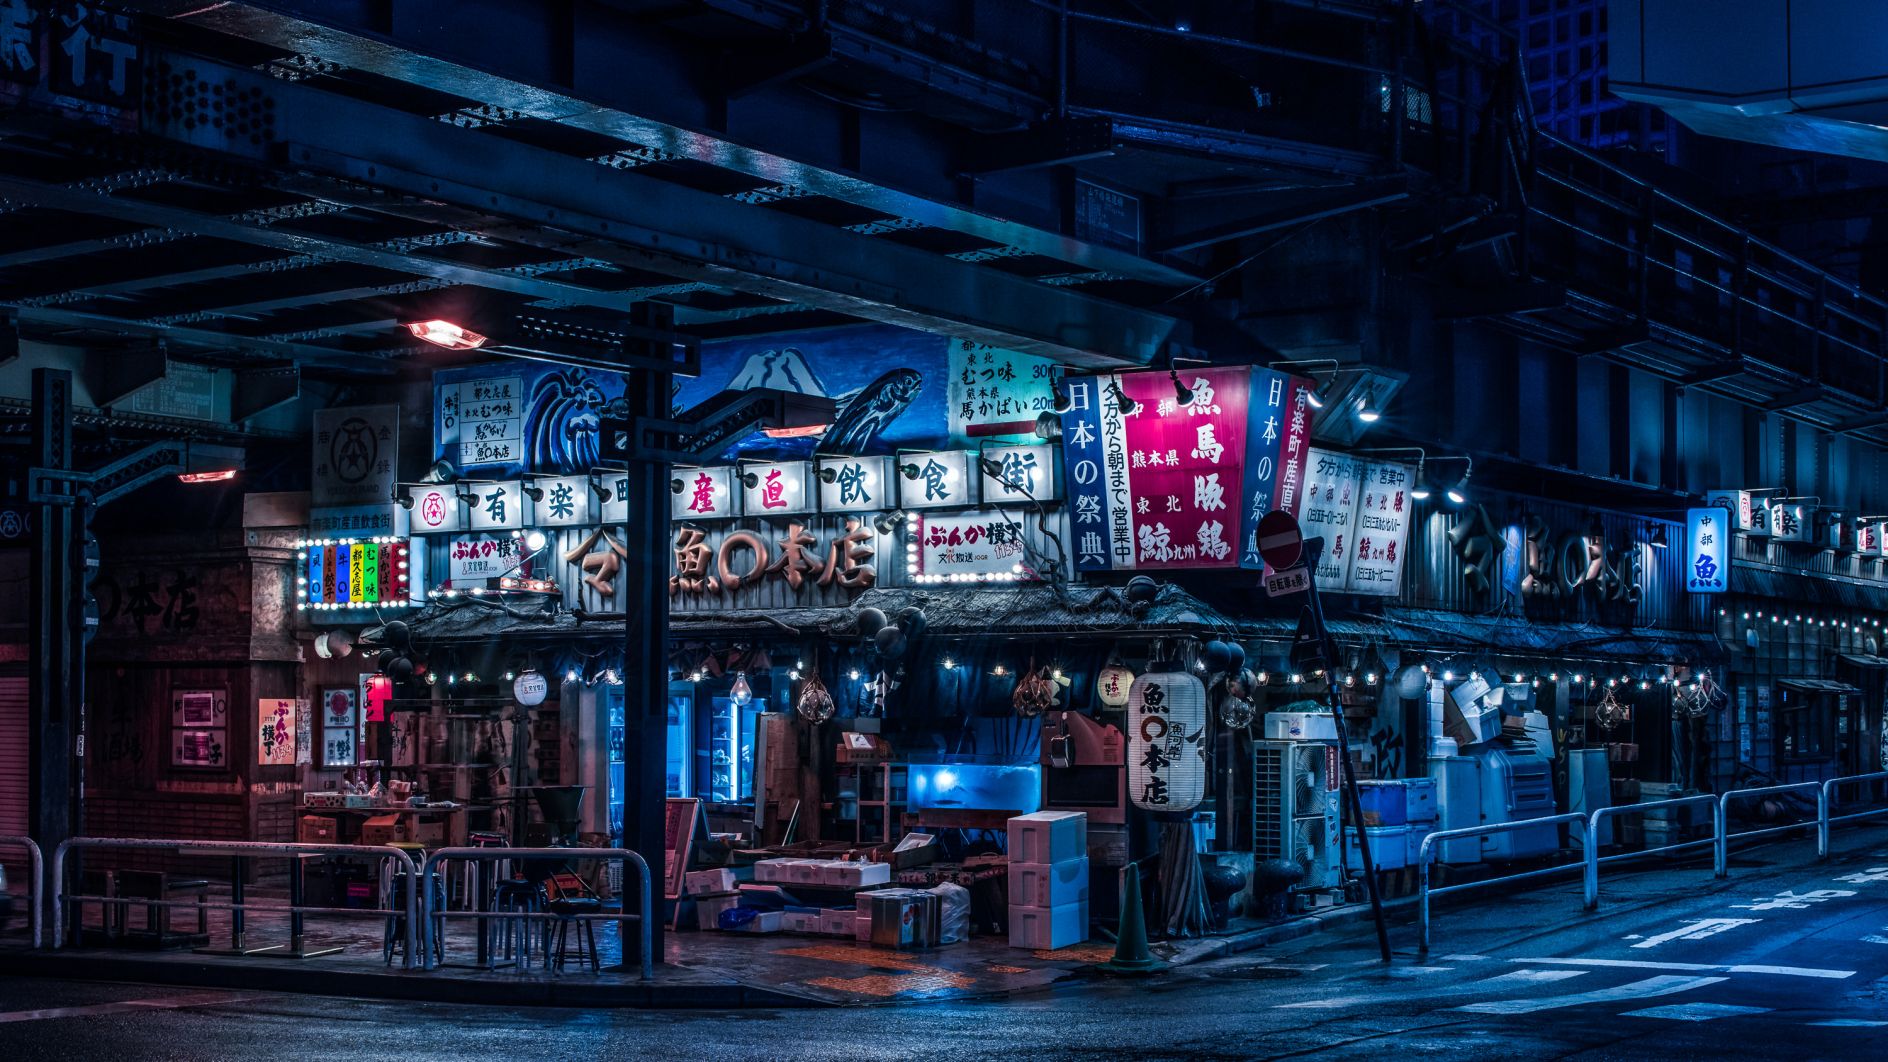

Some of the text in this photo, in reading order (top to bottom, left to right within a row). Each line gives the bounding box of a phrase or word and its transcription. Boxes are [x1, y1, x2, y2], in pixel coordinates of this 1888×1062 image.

[961, 361, 1016, 386] むつ味
[967, 352, 994, 366] 東北
[960, 397, 1028, 421] 馬かばい
[965, 387, 1000, 401] 熊本県
[1131, 376, 1222, 419] 中部 魚
[1131, 423, 1225, 469] 熊本県 馬
[1280, 386, 1309, 516] 有楽町産直
[687, 472, 716, 514] 産
[761, 468, 789, 511] 直
[836, 462, 872, 505] 飲
[919, 457, 952, 502] 食
[1000, 452, 1039, 496] 街
[1069, 382, 1106, 565] 日本の祭典
[1102, 383, 1131, 564] 夕方から朝まで営業中
[1136, 472, 1227, 515] 東北 豚
[485, 486, 507, 524] 有
[549, 482, 574, 520] 楽
[925, 520, 1023, 548] ぶんか横丁
[1137, 522, 1174, 563] 鯨
[1173, 519, 1231, 561] 九州 鶏
[1689, 515, 1722, 588] 中部 魚
[365, 547, 377, 596] むつ味
[379, 547, 390, 598] 馬かばい
[261, 724, 275, 756] 横丁
[273, 700, 289, 745] ぶんか
[1139, 682, 1170, 805] 魚〇本店
